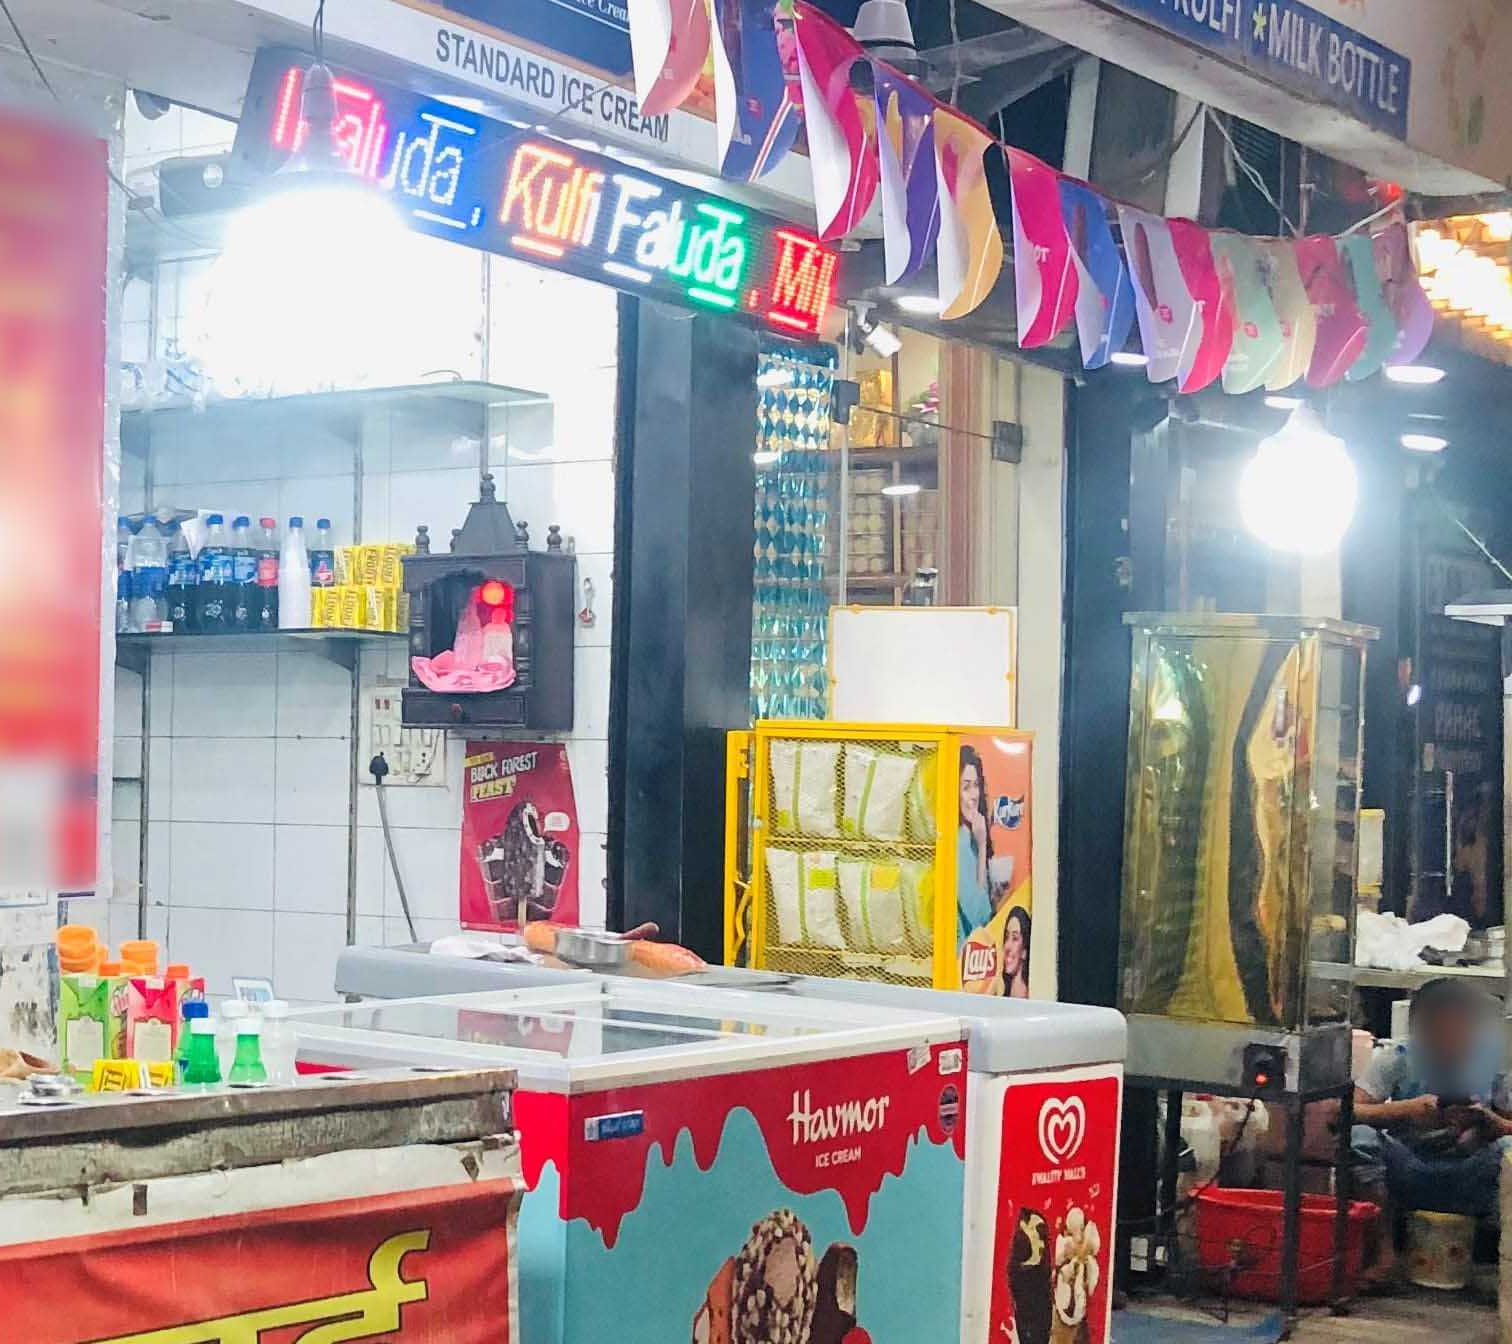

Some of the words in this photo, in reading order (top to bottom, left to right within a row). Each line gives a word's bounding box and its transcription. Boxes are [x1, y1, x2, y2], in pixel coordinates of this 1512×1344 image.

[436, 29, 555, 100] STANDARD
[561, 70, 594, 112] ICE
[598, 90, 670, 143] CREAM
[1268, 2, 1323, 76] MILK
[1328, 33, 1401, 115] BOTTLE
[502, 752, 538, 776] FOREST
[787, 1089, 890, 1146] Havmor
[815, 1150, 830, 1168] ICE
[832, 1145, 862, 1166] CREAM
